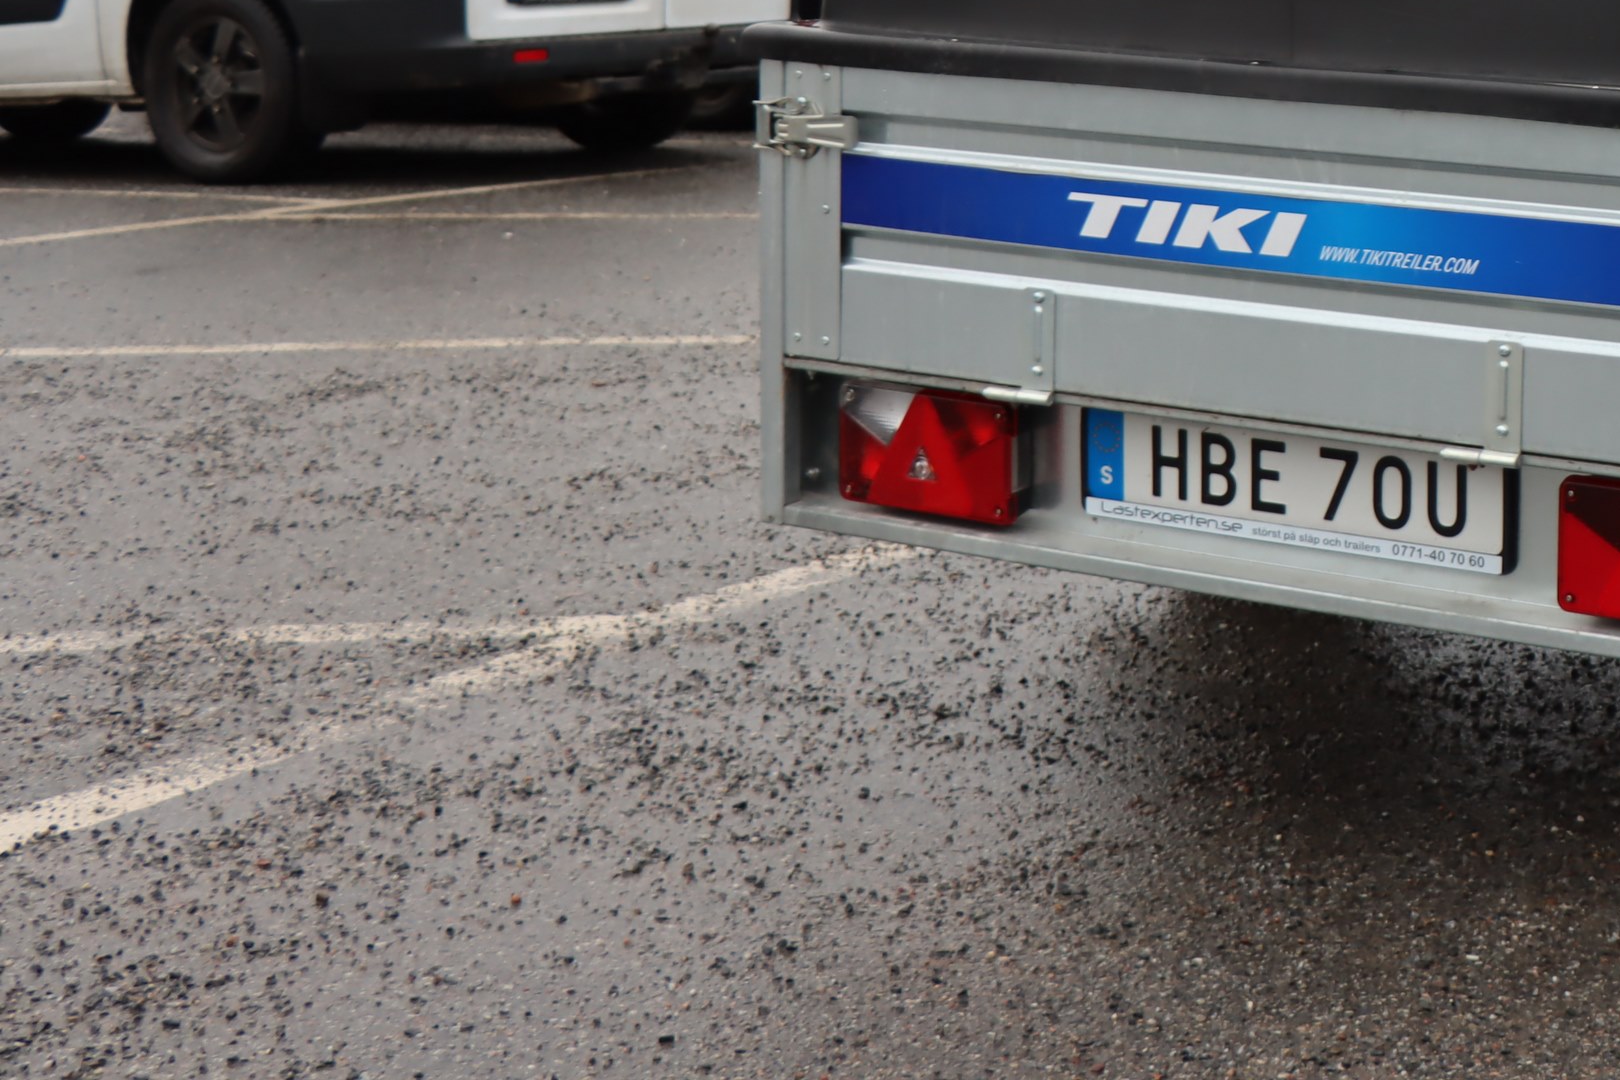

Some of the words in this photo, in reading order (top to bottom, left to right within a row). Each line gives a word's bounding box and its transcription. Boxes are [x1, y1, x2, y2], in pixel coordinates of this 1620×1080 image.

[1067, 191, 1308, 258] TIKI
[1100, 465, 1114, 485] S
[1151, 424, 1287, 515] HBE
[1319, 446, 1468, 538] 70U
[1100, 500, 1244, 533] Lastexperten.se
[1252, 526, 1282, 540] störst
[1283, 531, 1297, 542] på
[1299, 532, 1321, 546] släp
[1322, 537, 1342, 548] och
[1344, 538, 1381, 554] trailers
[1391, 543, 1446, 563] 0771-40
[1450, 552, 1466, 566] 70
[1468, 554, 1486, 569] 60
